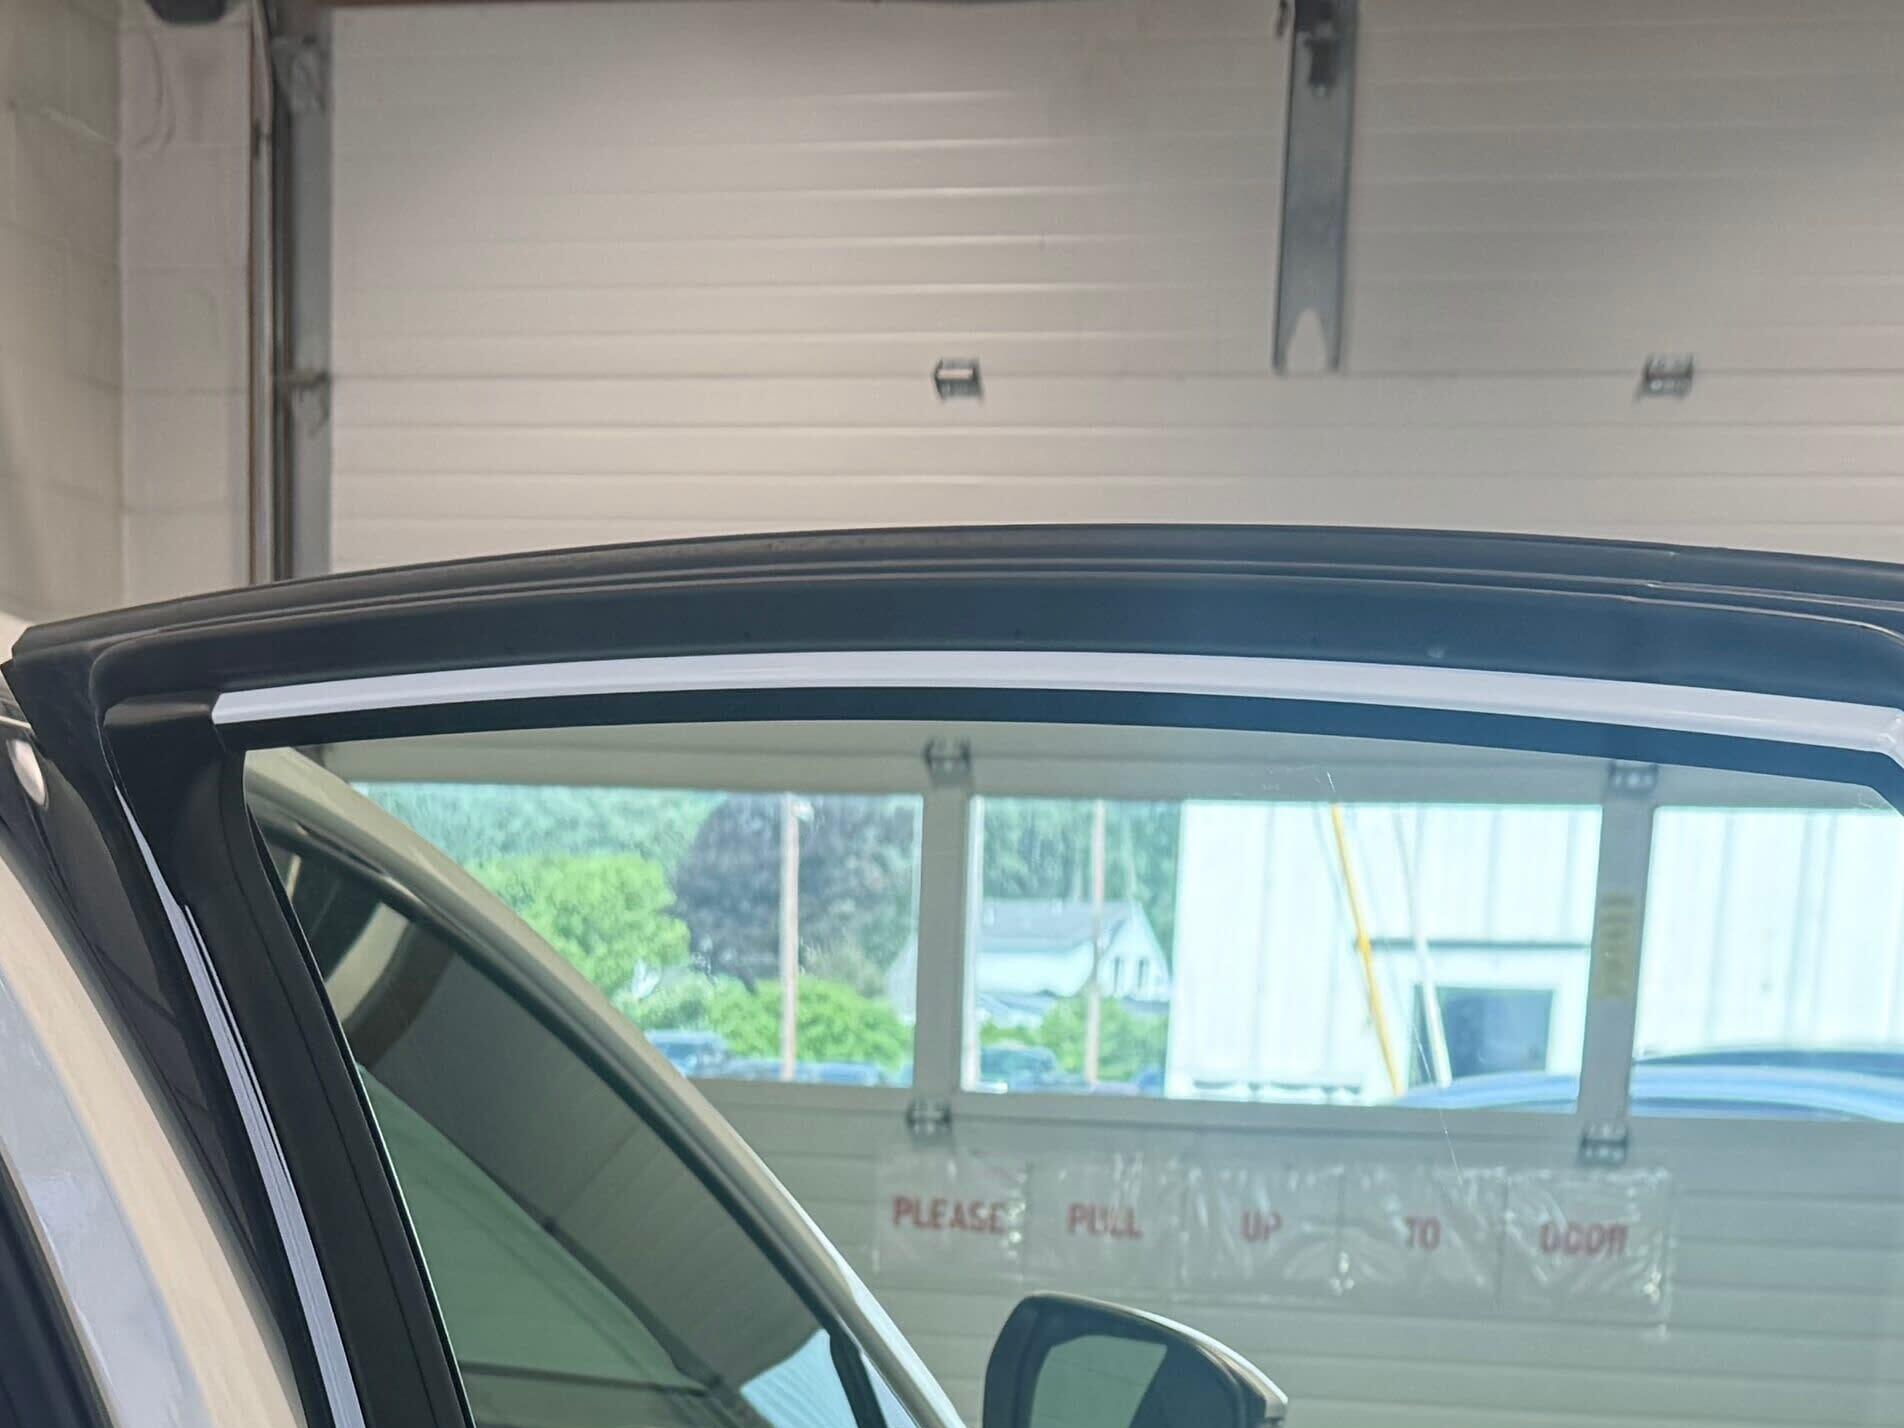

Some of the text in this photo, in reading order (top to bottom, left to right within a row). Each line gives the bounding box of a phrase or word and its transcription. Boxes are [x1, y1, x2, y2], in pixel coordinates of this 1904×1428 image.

[891, 1196, 1007, 1235] PLEASE
[1067, 1202, 1143, 1239] PULL
[1241, 1209, 1282, 1244] UP
[1405, 1214, 1442, 1252] TO
